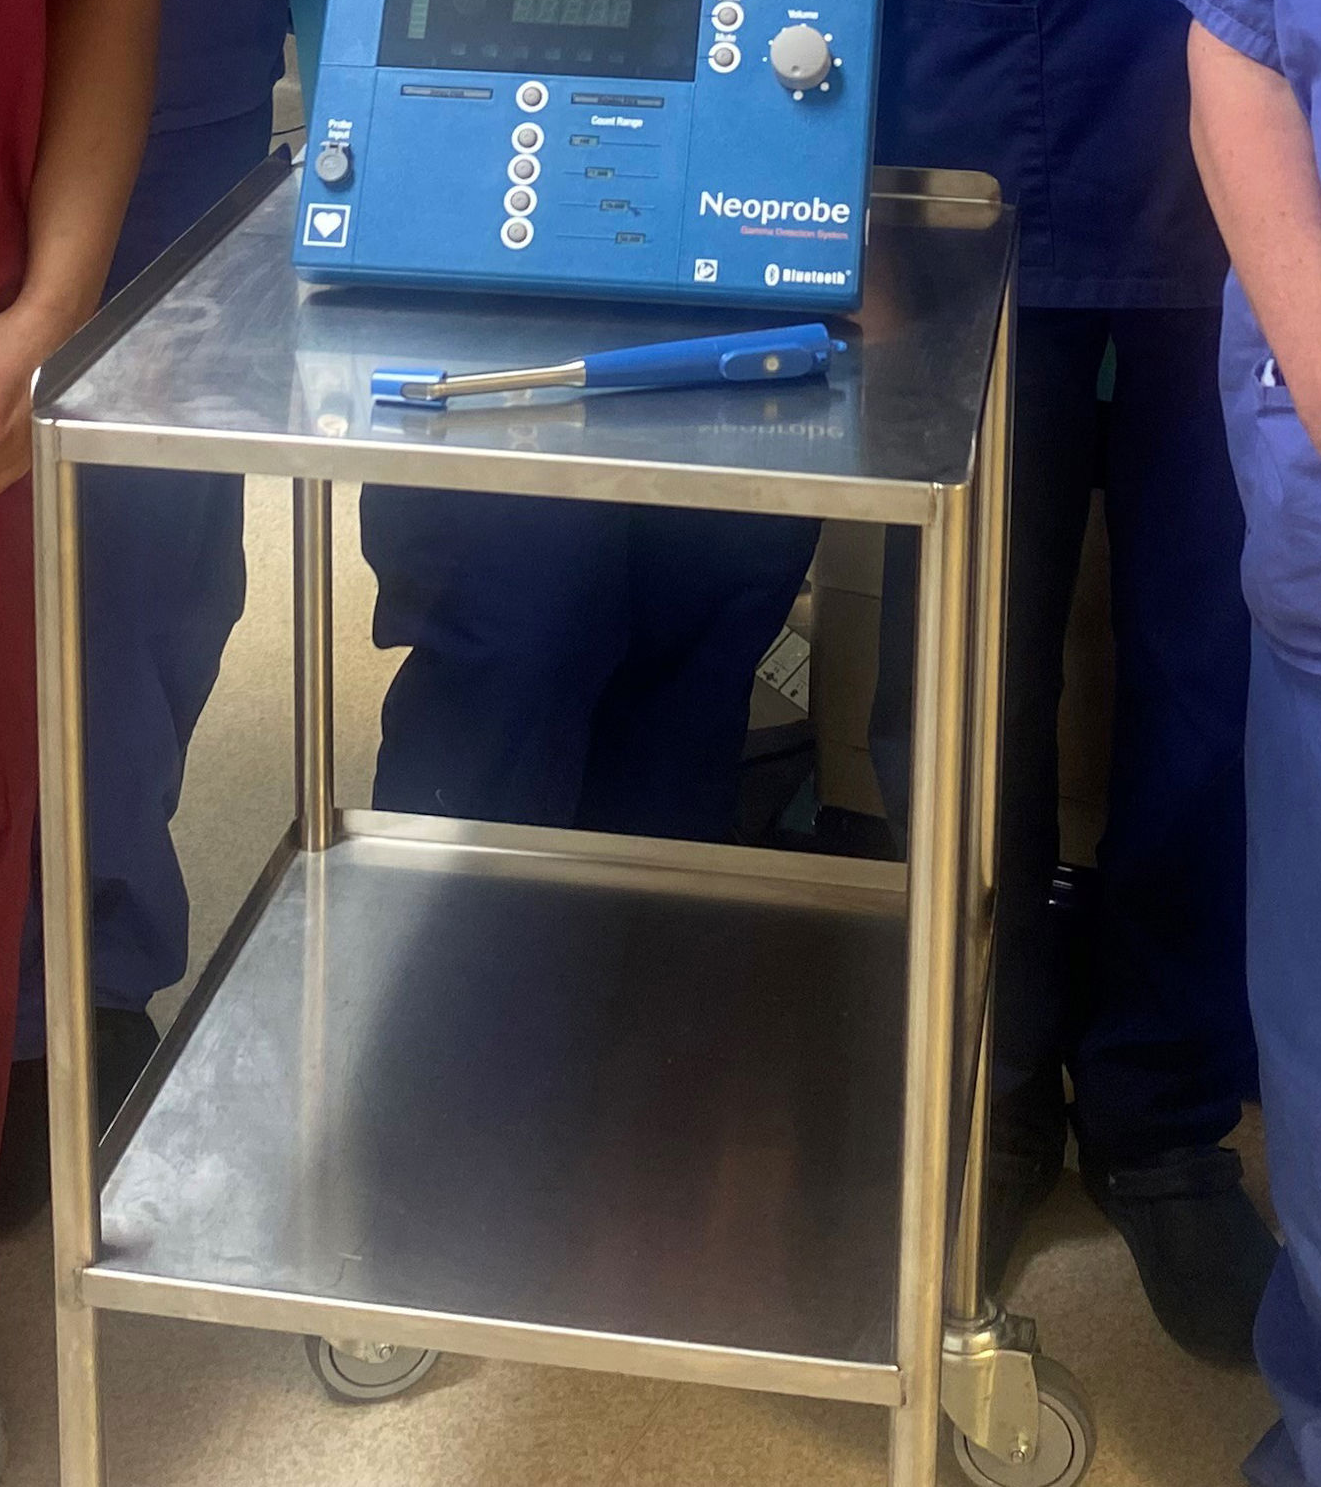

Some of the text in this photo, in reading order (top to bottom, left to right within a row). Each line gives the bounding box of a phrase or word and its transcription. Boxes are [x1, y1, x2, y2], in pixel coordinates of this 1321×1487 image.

[328, 118, 353, 130] Probe
[591, 114, 644, 129] Count Range
[699, 190, 851, 225] Neoprobe
